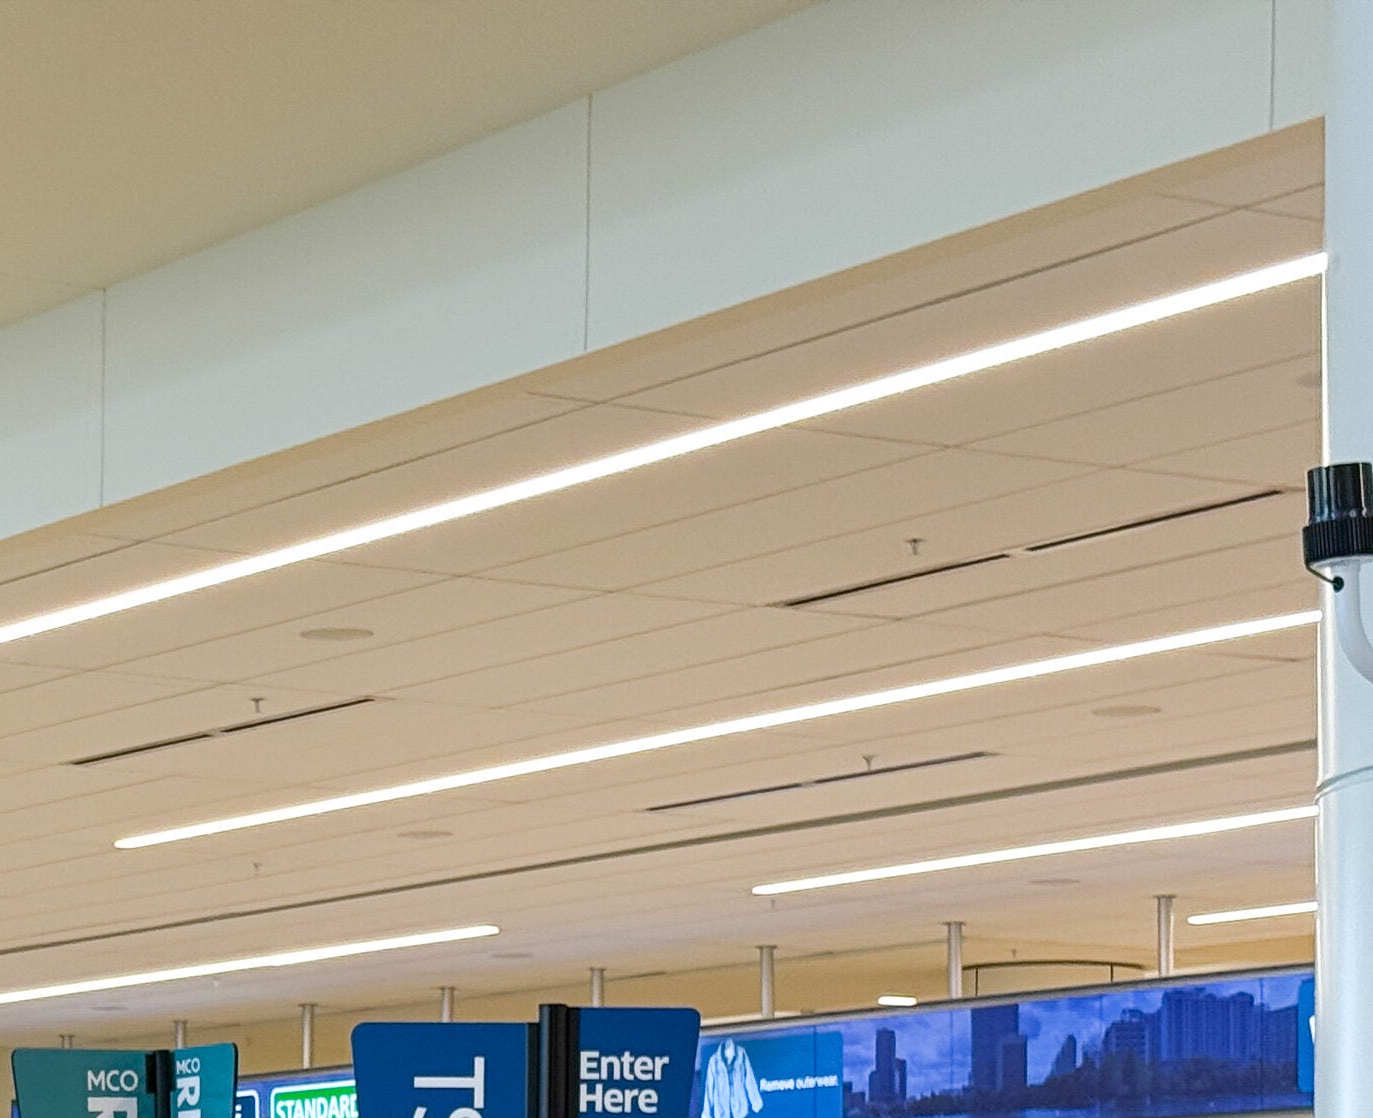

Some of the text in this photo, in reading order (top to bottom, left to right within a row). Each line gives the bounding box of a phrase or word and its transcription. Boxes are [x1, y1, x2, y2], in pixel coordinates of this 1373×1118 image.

[176, 1057, 201, 1075] MCO
[580, 1050, 670, 1081] Enter
[87, 1069, 139, 1092] MCO
[579, 1083, 659, 1114] Here
